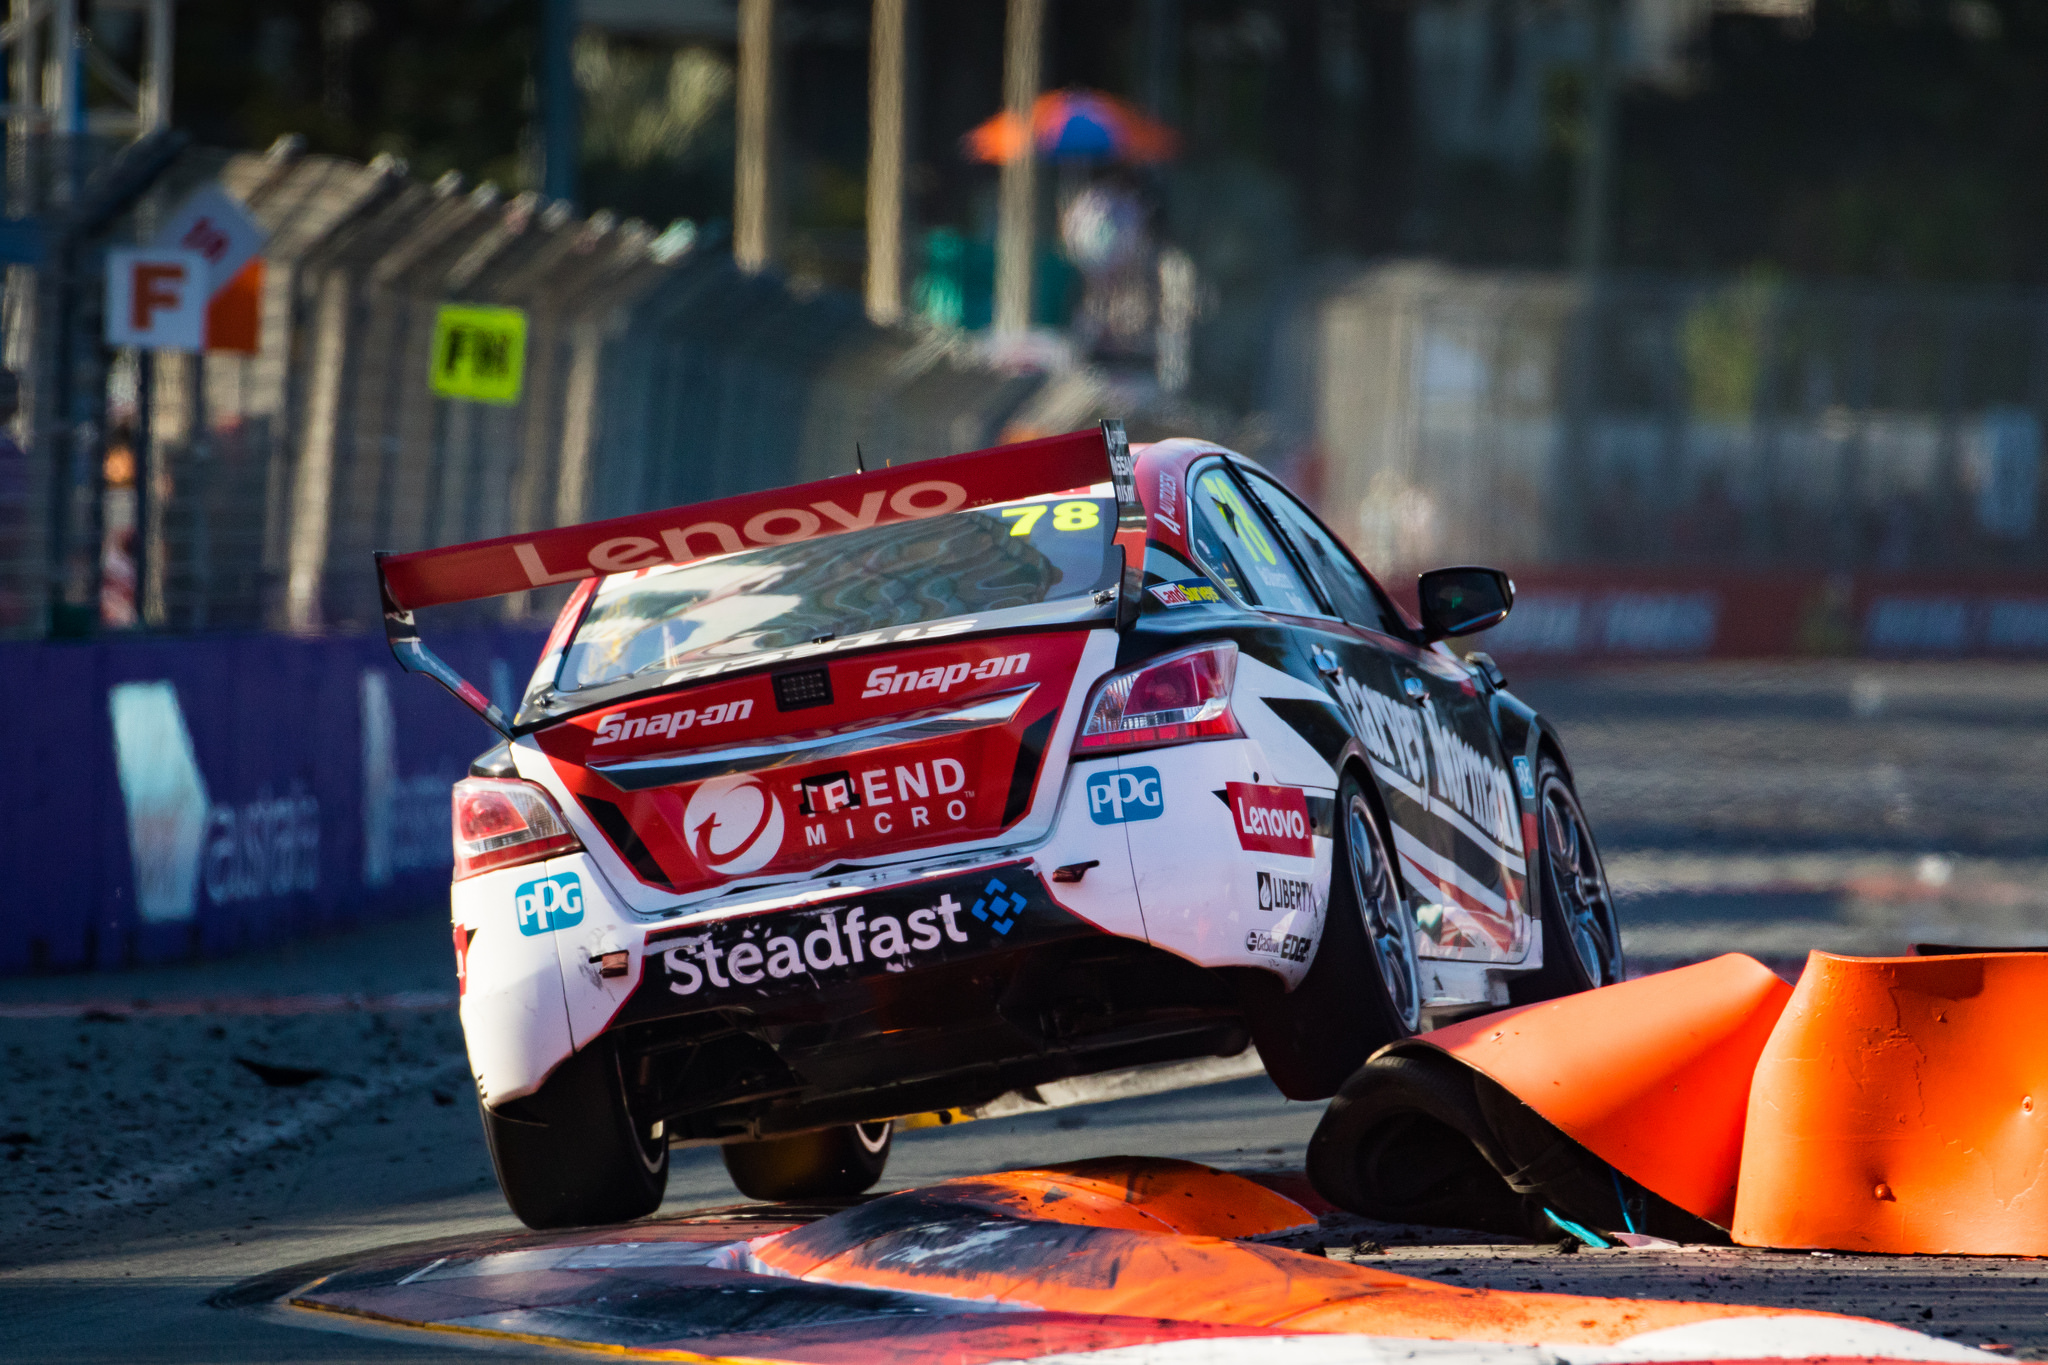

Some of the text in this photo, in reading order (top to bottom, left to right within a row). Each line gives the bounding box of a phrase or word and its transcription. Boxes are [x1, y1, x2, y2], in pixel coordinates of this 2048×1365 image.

[130, 263, 187, 332] F
[513, 480, 968, 587] Lenovo
[1001, 501, 1100, 536] 78
[861, 652, 1031, 699] Snap-on
[592, 698, 754, 747] Snap-on
[792, 757, 966, 818] TREND
[1090, 773, 1161, 819] PPG
[1421, 699, 1523, 852] Norman
[805, 799, 967, 846] MICRO
[1238, 797, 1305, 840] Lenovo
[516, 879, 583, 930] PPG
[1273, 877, 1314, 913] LIBERTY
[663, 894, 969, 996] Steadfast
[1281, 934, 1312, 962] EDGE
